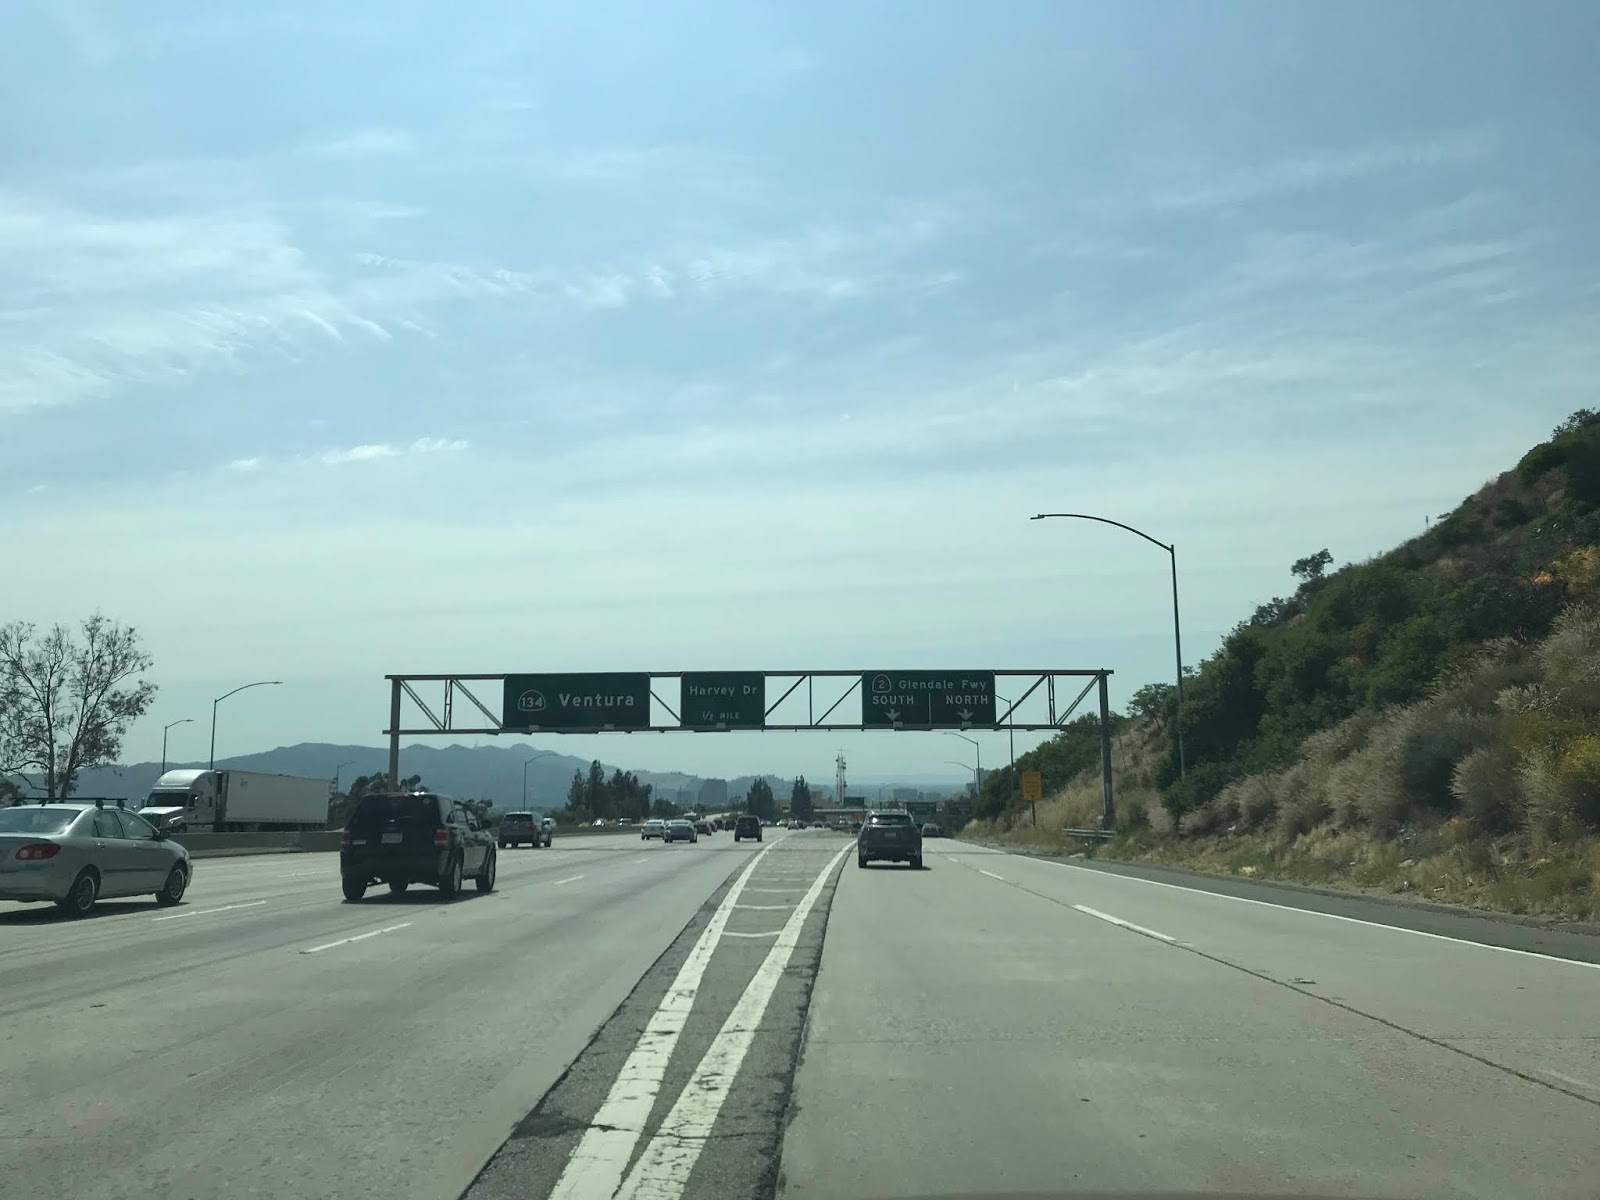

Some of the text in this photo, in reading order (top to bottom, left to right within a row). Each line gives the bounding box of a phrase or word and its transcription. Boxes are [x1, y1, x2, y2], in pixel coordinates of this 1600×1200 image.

[689, 685, 758, 697] Harvey Dr
[899, 680, 987, 691] Glendale Fwy
[521, 693, 635, 708] 134 Ventura
[872, 695, 914, 705] SOUTH
[946, 695, 988, 705] NORTH
